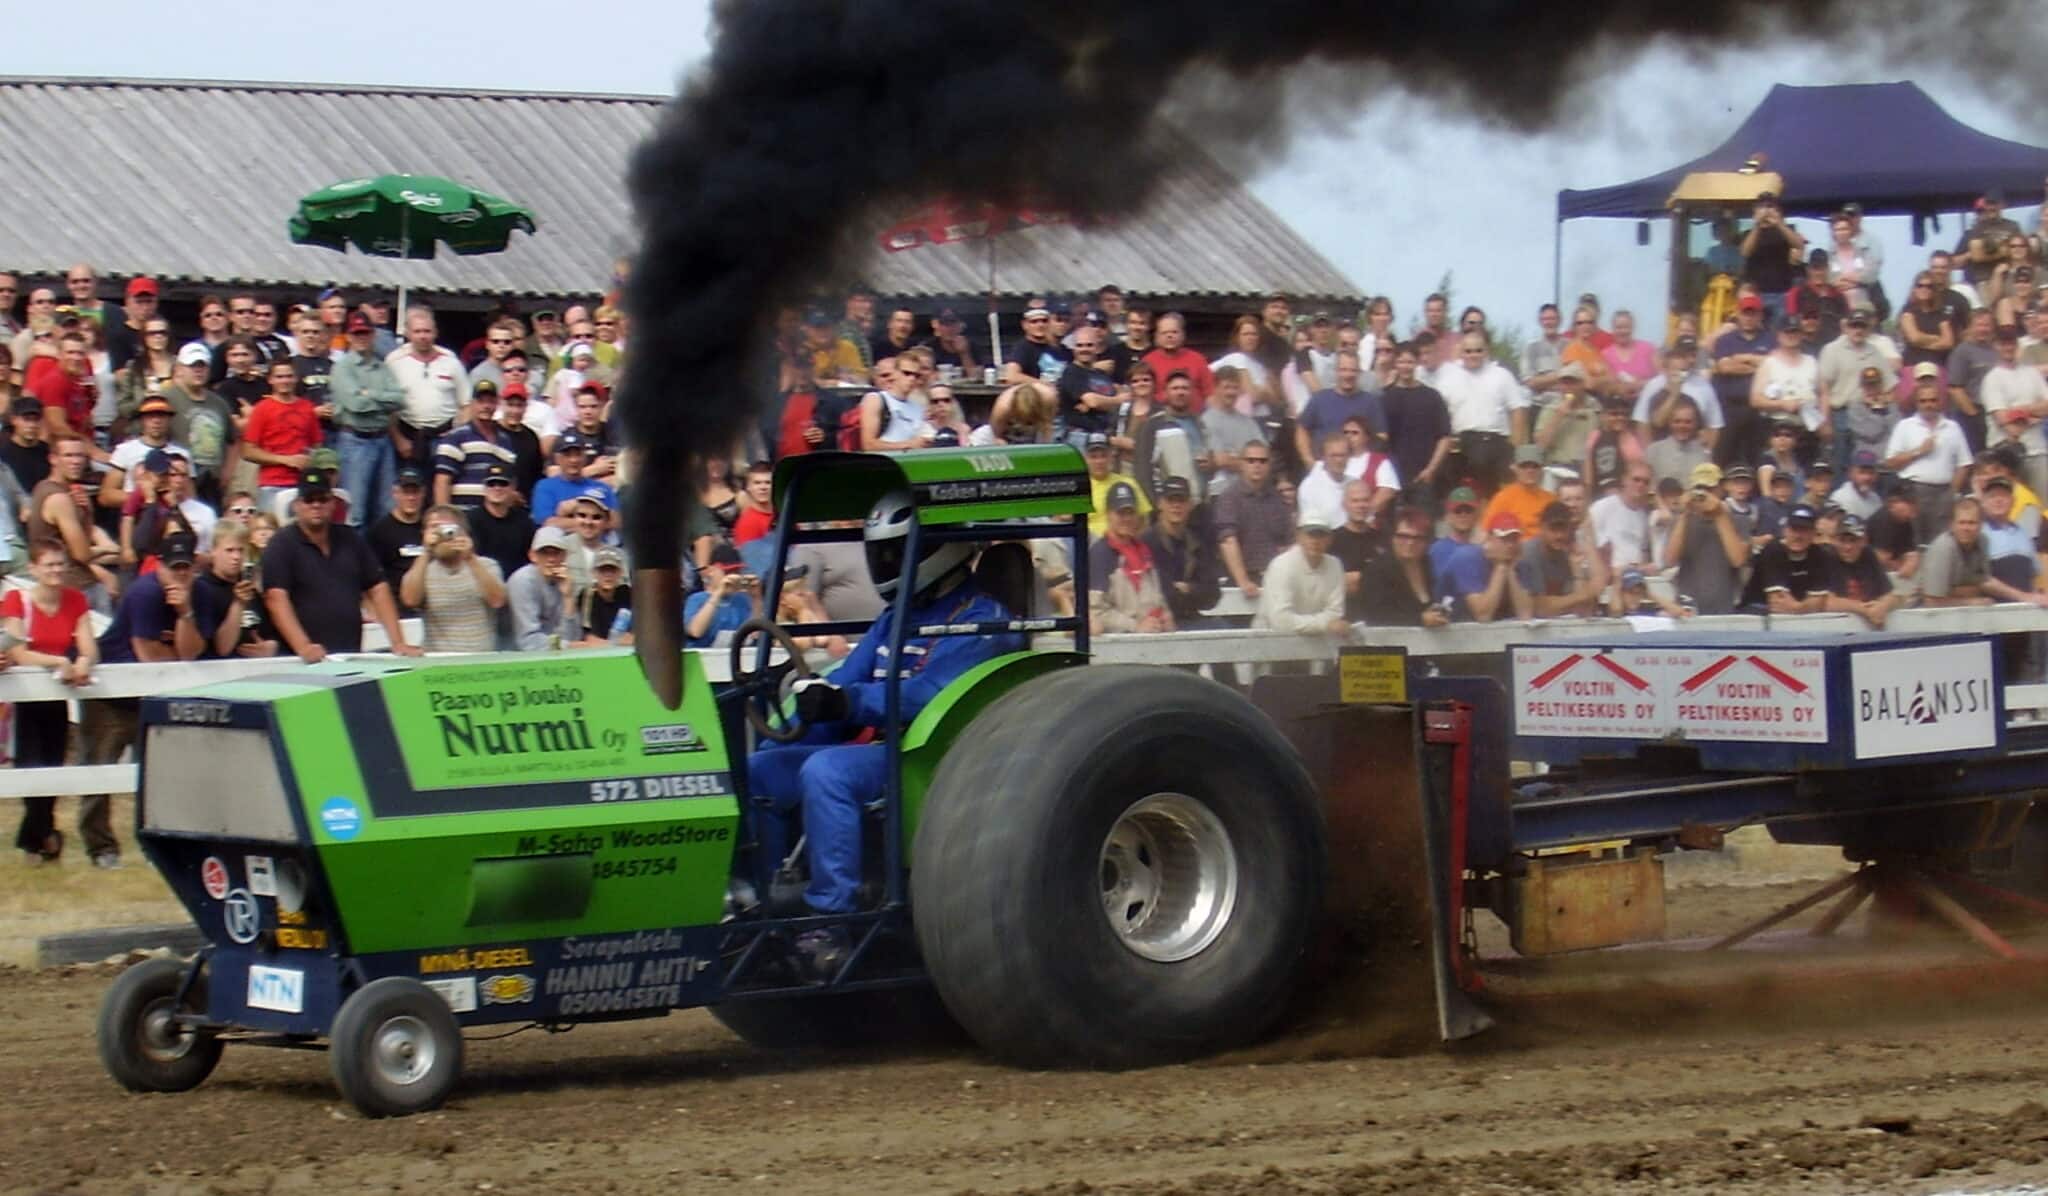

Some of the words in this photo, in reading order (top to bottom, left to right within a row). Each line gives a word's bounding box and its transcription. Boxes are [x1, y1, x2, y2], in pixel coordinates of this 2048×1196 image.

[428, 690, 494, 712] Paavo
[500, 691, 518, 714] ja
[521, 684, 583, 706] Jouko
[1563, 681, 1615, 696] VOLTIN
[1716, 684, 1771, 699] VOLTIN
[167, 703, 233, 723] DEUTZ
[1527, 702, 1626, 718] PELTIKESKUS
[1635, 703, 1655, 718] OY
[1678, 705, 1783, 721] PELTIKESKUS
[1793, 707, 1815, 722] OY
[434, 708, 597, 758] Nurmi
[602, 729, 628, 752] Oy
[590, 780, 638, 802] 572
[644, 774, 725, 799] DIESEL
[611, 823, 729, 848] WoodStore
[251, 973, 298, 1001] NTN
[545, 962, 635, 995] HANNU
[640, 956, 697, 984] AHTI
